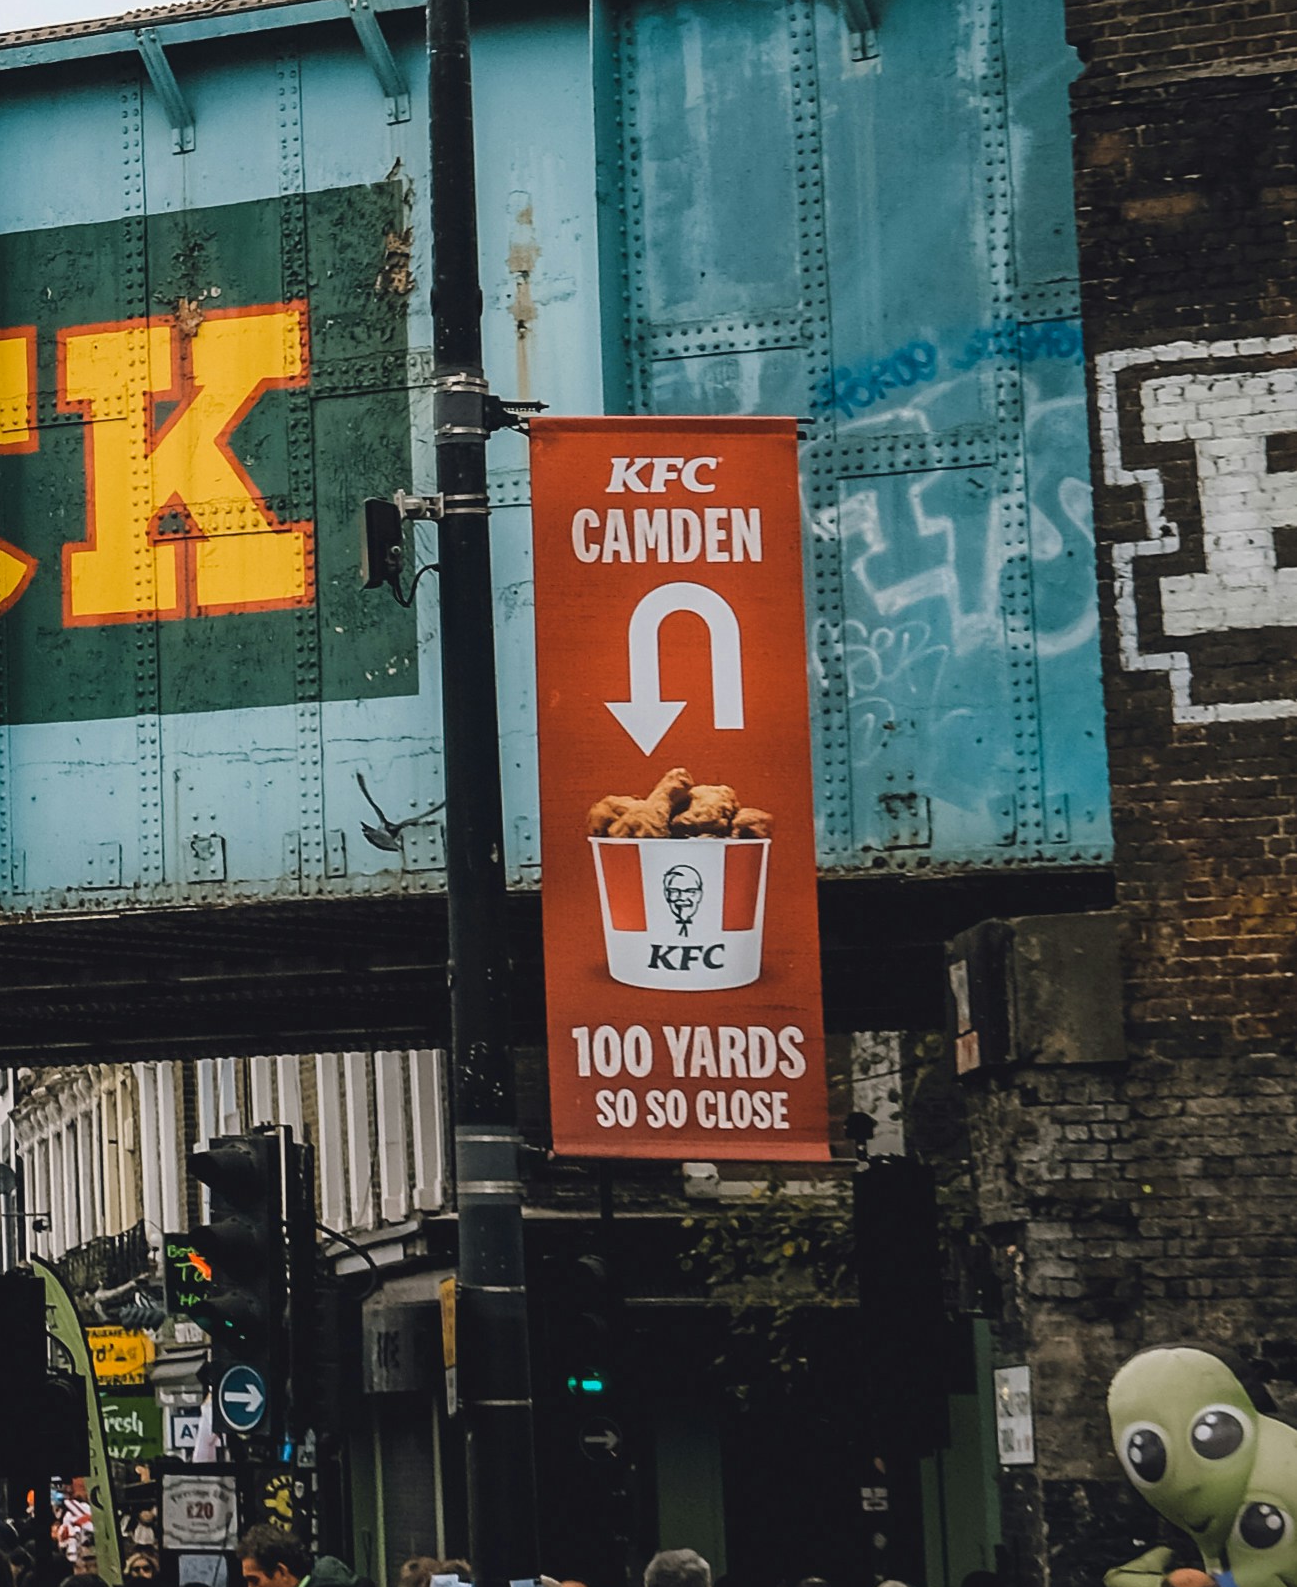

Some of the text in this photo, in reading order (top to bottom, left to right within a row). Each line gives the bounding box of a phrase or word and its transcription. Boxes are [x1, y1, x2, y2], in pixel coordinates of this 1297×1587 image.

[605, 456, 718, 494] KFC
[571, 507, 763, 564] CAMDEN
[647, 943, 726, 971] KFC
[571, 1024, 807, 1080] 100 YARDS
[595, 1088, 791, 1130] SO SO CLOSE
